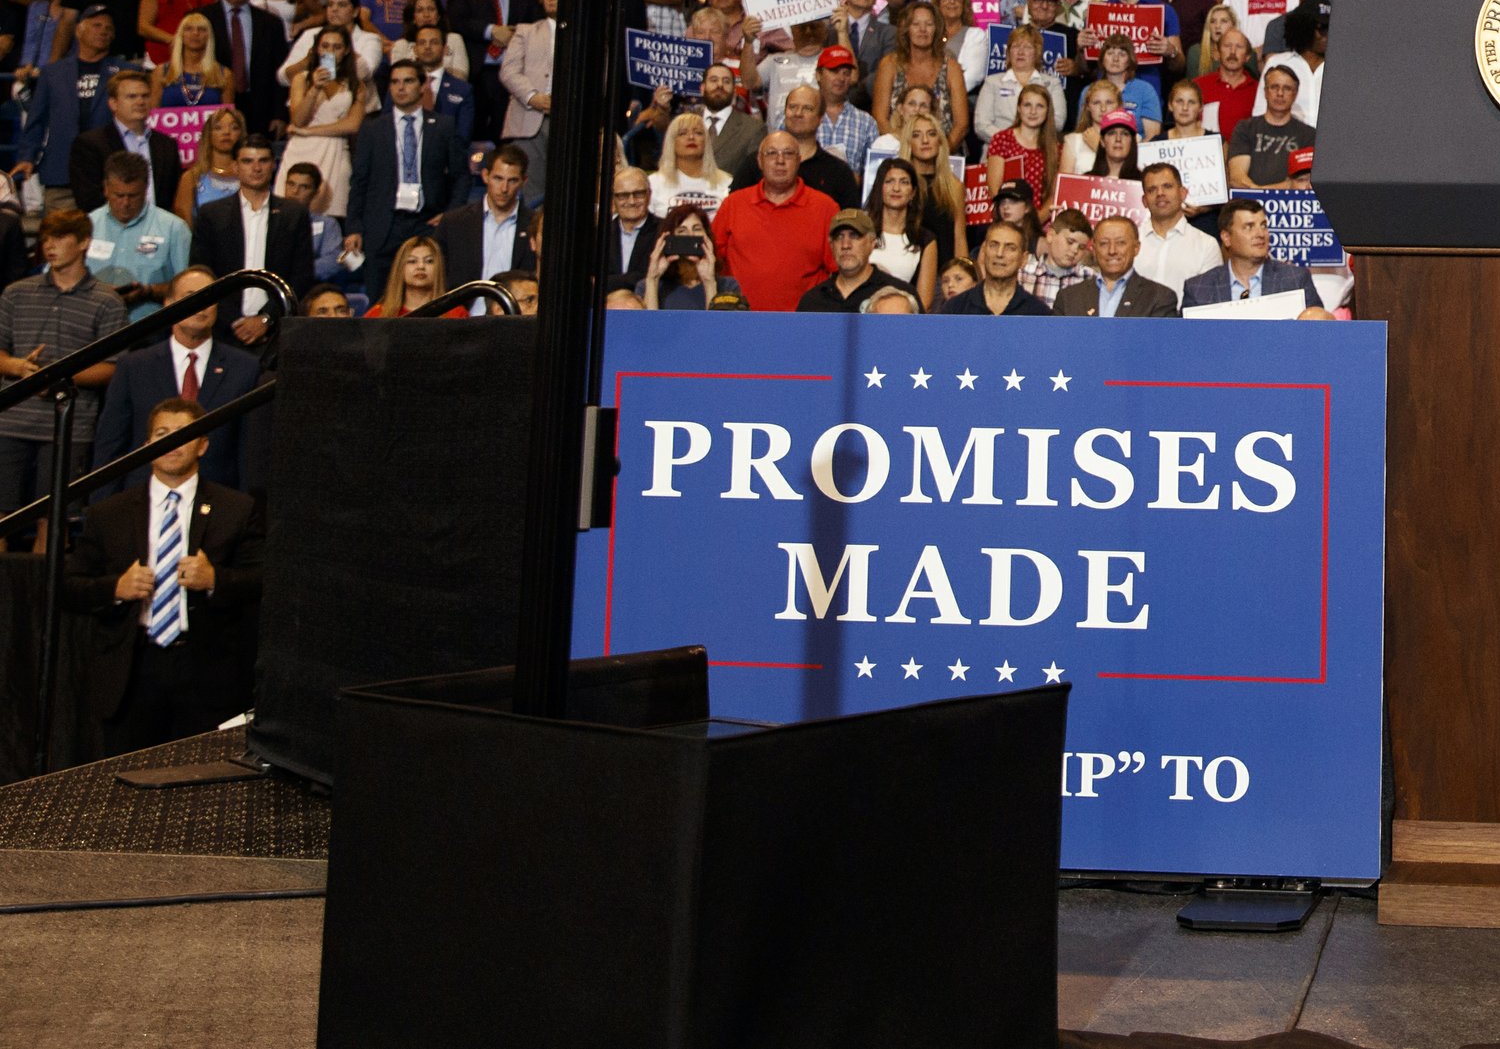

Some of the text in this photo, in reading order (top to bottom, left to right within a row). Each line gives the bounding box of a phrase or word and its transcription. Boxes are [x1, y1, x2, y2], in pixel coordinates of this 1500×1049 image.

[1108, 12, 1136, 23] MAKE
[1088, 24, 1161, 42] AMERICA
[634, 36, 704, 59] PROMISES
[1485, 40, 1497, 66] THE
[649, 50, 689, 67] MADE
[635, 60, 704, 82] PROMISES
[649, 75, 687, 91] KEPT
[145, 109, 214, 128] WOME
[1158, 145, 1185, 159] BUY
[1255, 133, 1299, 154] 1776
[675, 199, 717, 207] TRUMP
[1091, 188, 1127, 203] MAKE
[1060, 200, 1142, 222] AMERIC
[1258, 199, 1325, 215] OMISE
[1266, 214, 1314, 229] MADE
[1269, 232, 1334, 247] OMISES
[641, 419, 1297, 514] PROMISES
[775, 542, 1150, 630] MADE
[1161, 754, 1251, 804] TO
